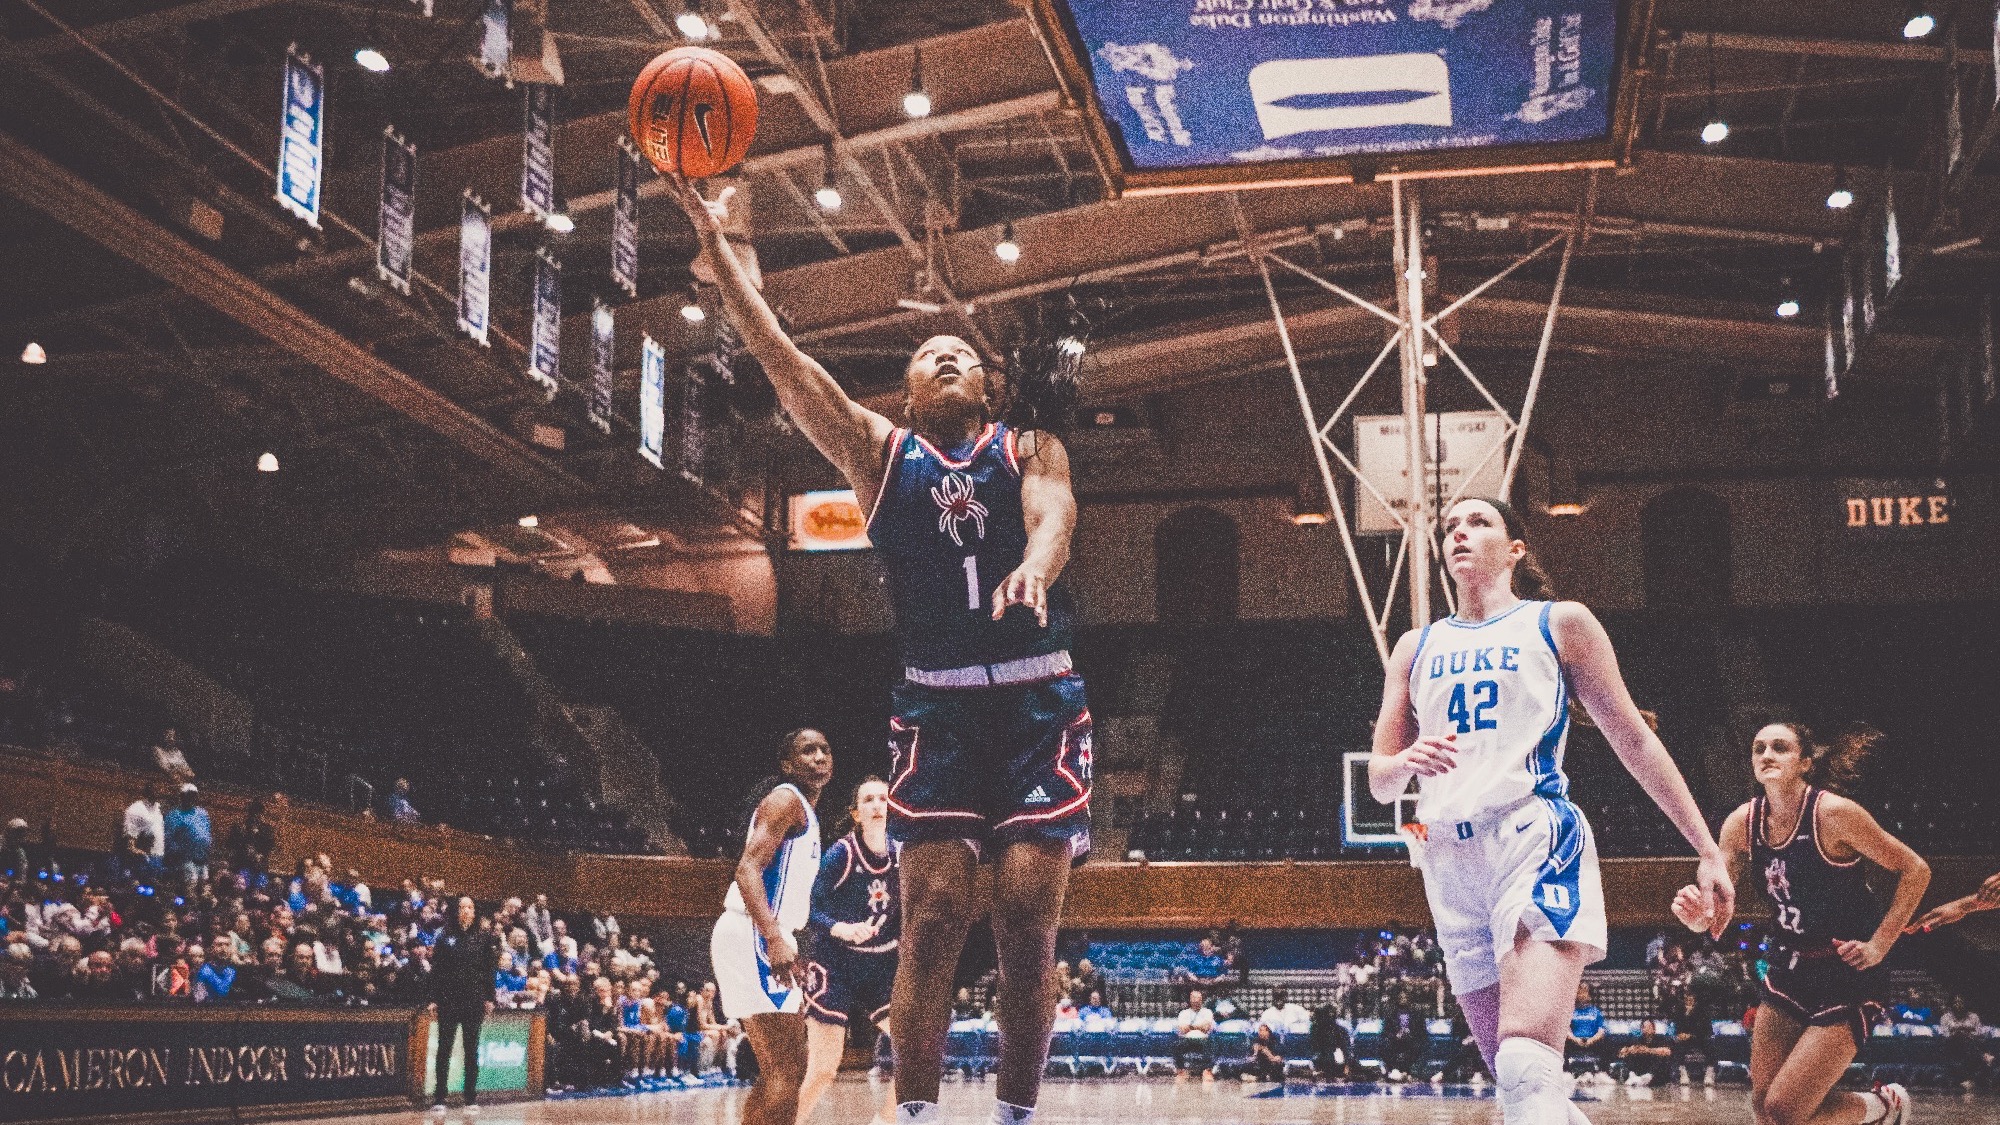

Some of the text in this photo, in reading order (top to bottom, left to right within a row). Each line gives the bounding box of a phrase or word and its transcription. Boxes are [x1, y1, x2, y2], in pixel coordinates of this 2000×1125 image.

[1190, 13, 1251, 29] Duke
[1847, 496, 1949, 527] DUKE
[962, 555, 980, 610] 1
[1429, 646, 1520, 680] DUKE
[1447, 680, 1499, 734] 42
[3, 1043, 397, 1093] CAMERON INDOOR STADIUM
